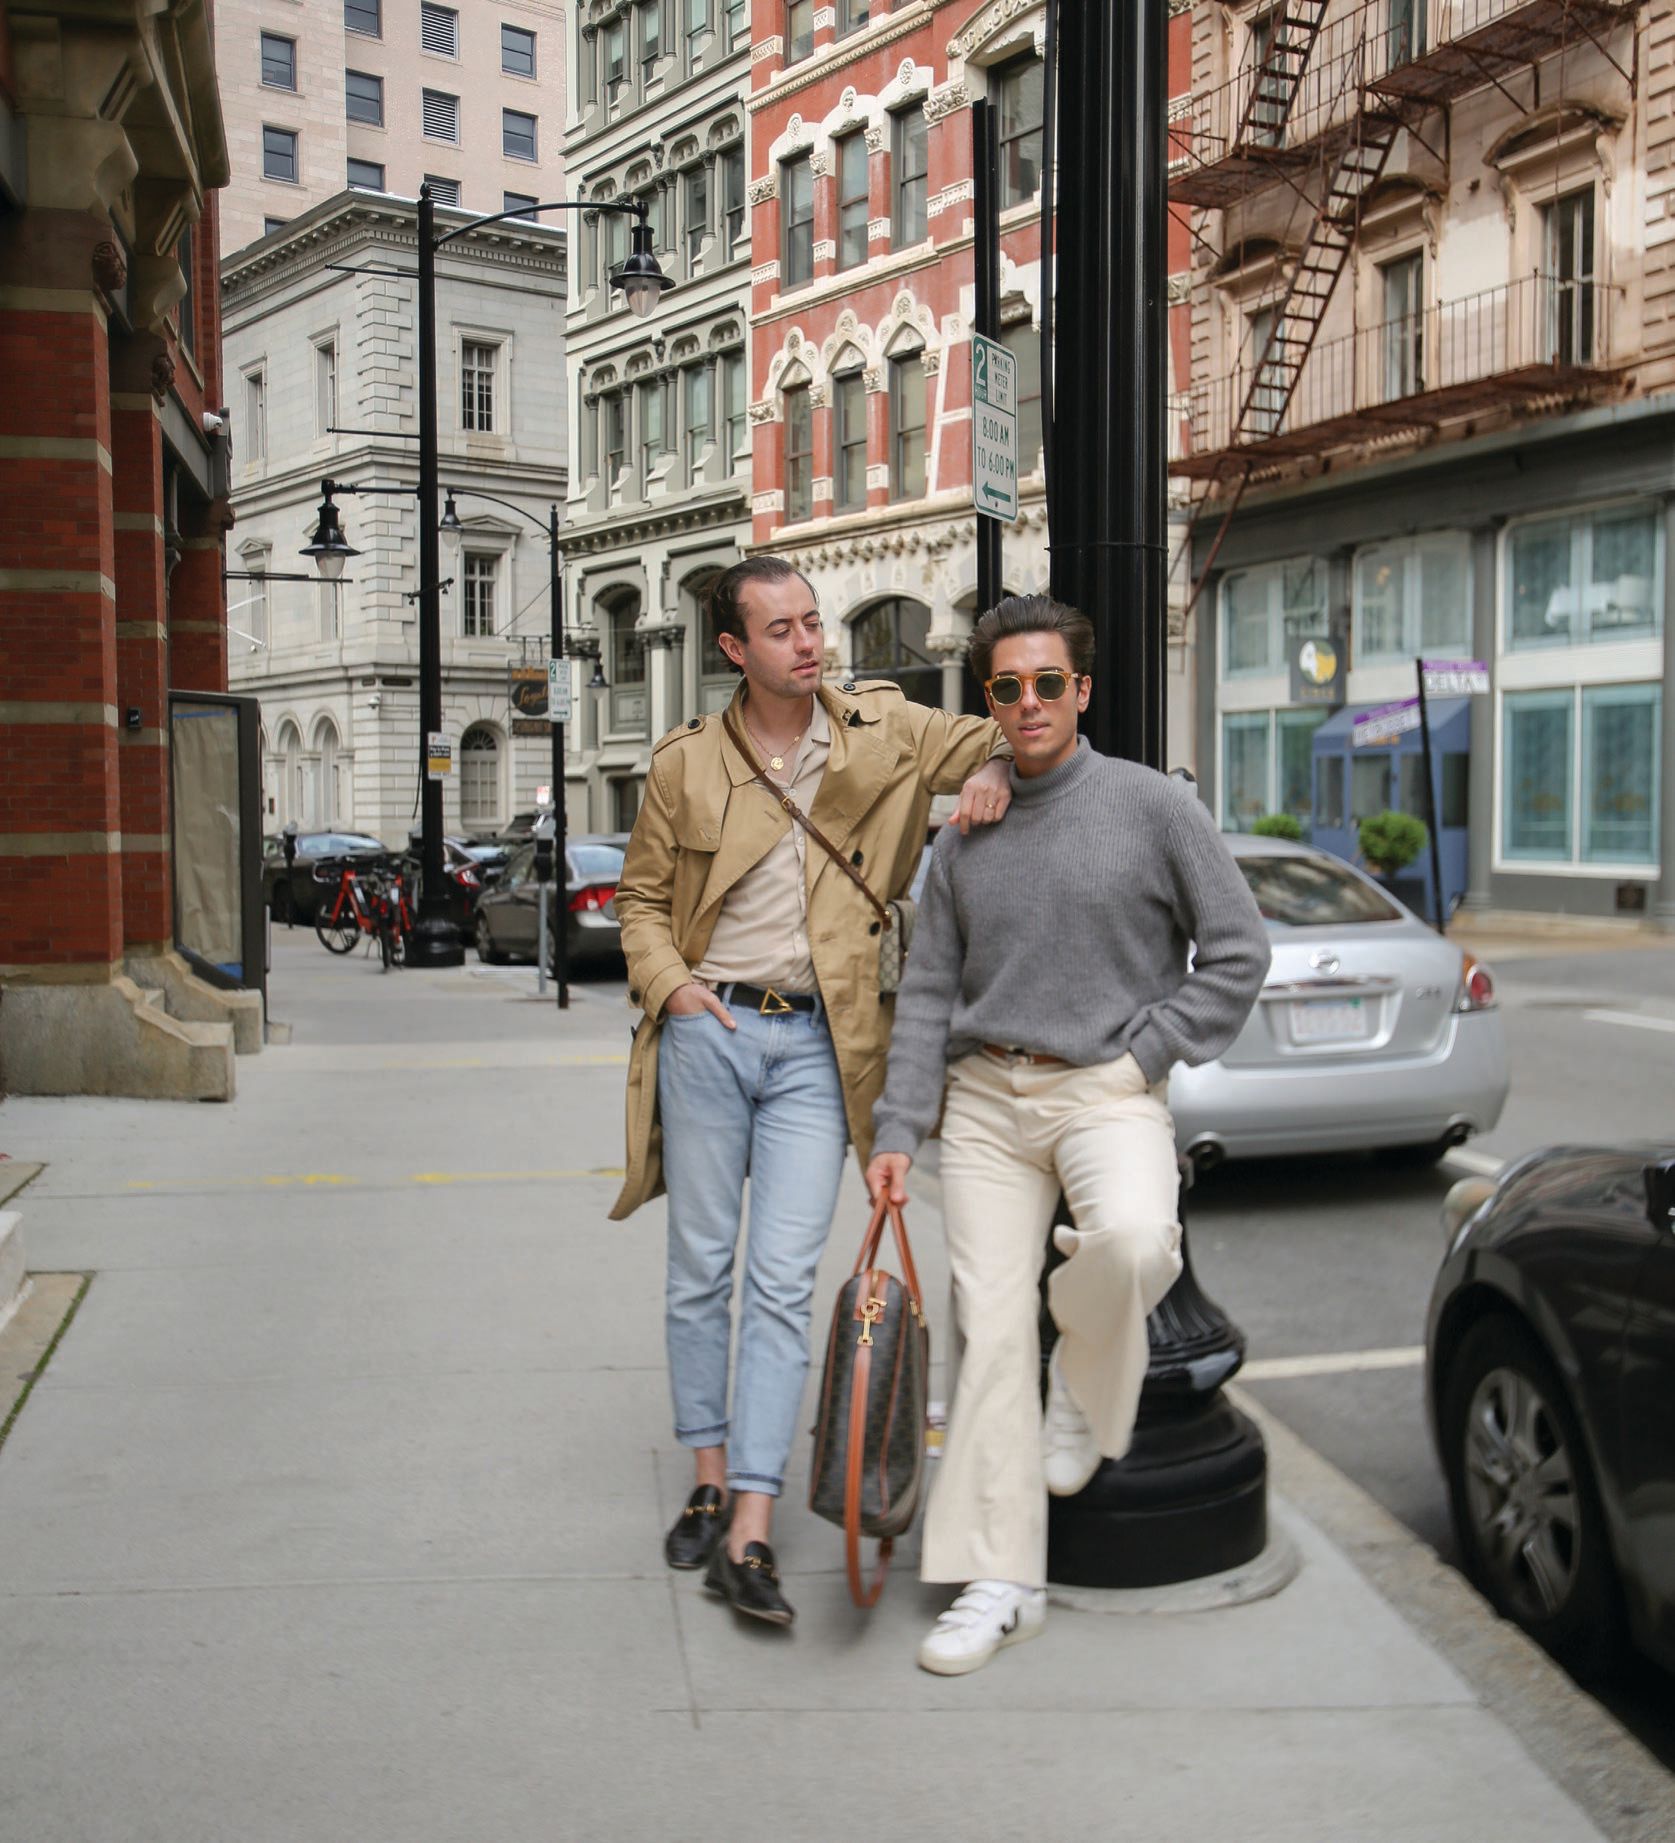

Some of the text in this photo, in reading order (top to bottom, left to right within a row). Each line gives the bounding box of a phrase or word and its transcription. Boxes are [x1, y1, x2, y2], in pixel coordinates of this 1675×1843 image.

[975, 343, 986, 387] 2
[992, 353, 1010, 374] PARKING
[994, 373, 1008, 391] METER
[995, 389, 1008, 407] LIMIT
[1000, 424, 1009, 448] AM
[977, 446, 986, 469] TO
[1005, 457, 1015, 481] PM
[550, 662, 556, 677] 2
